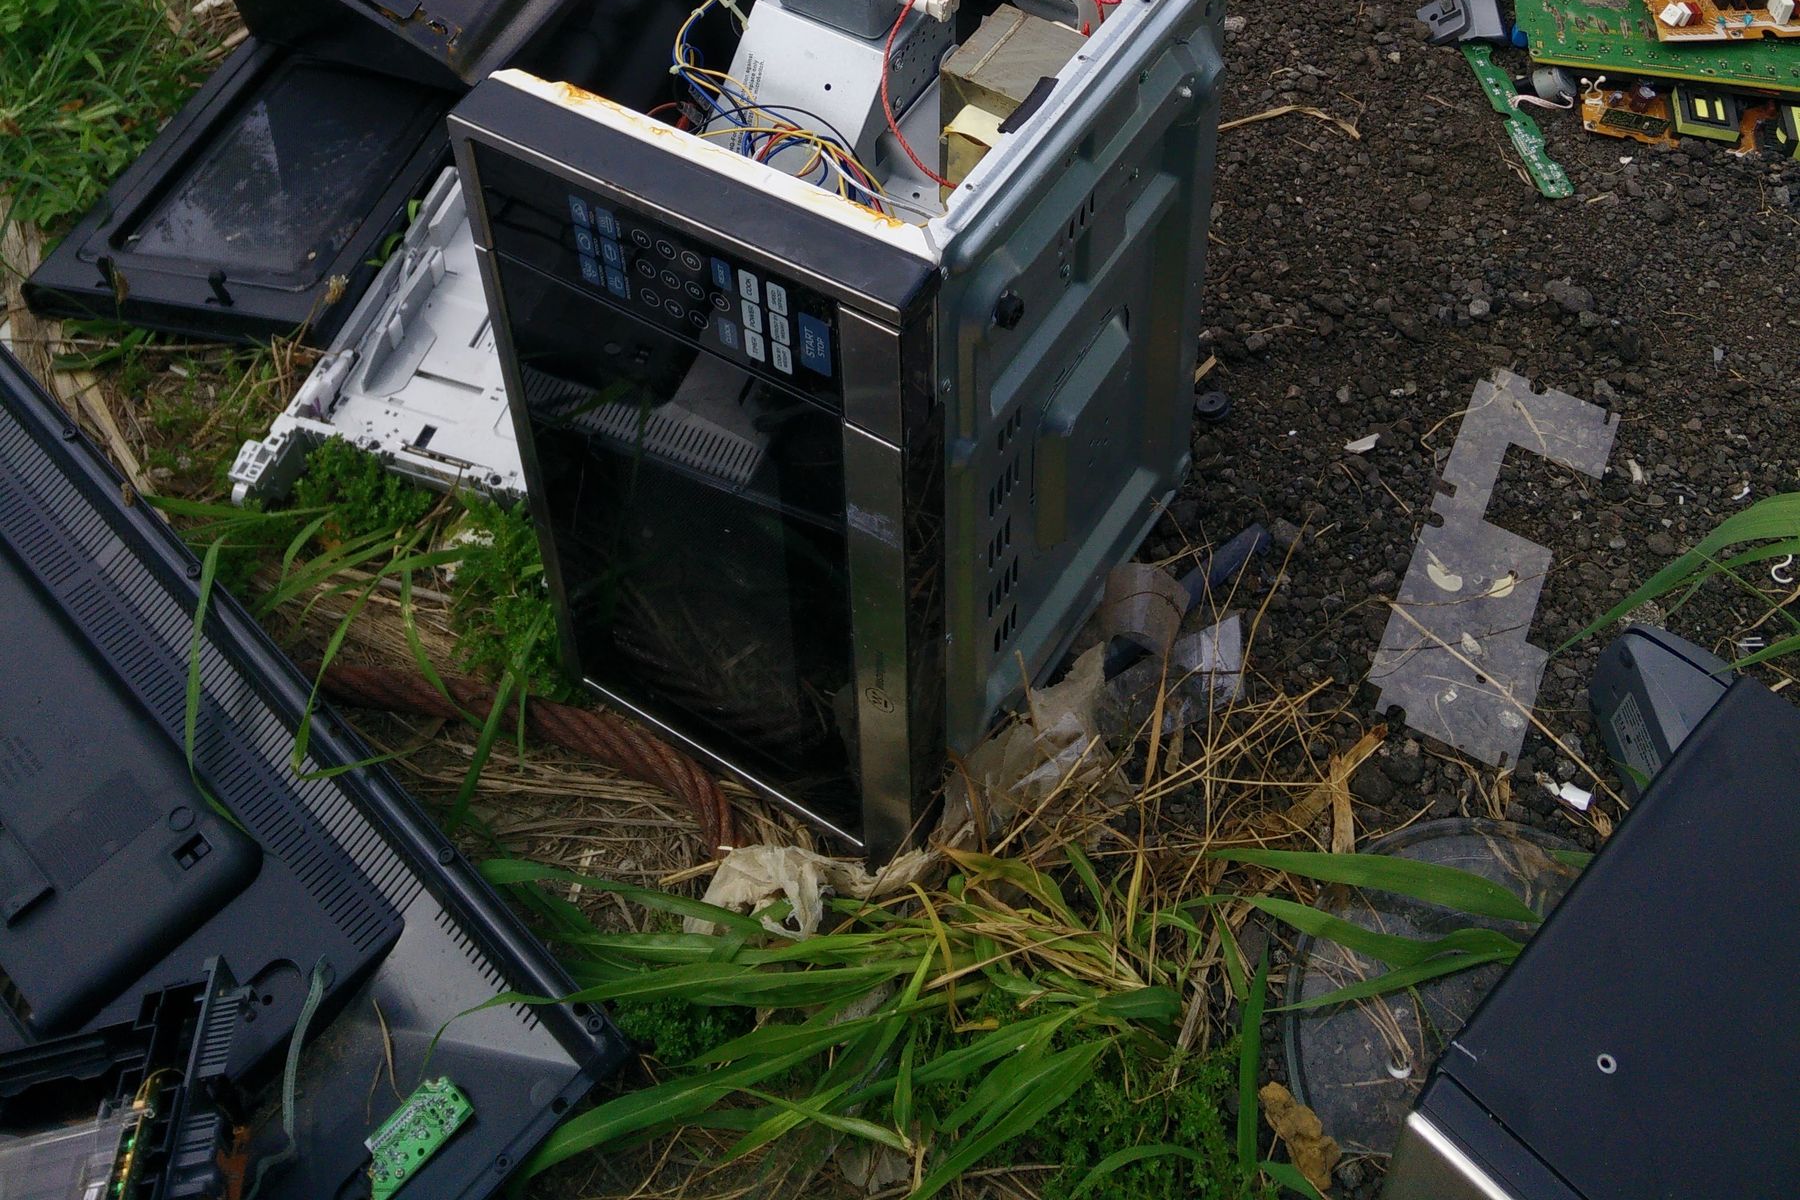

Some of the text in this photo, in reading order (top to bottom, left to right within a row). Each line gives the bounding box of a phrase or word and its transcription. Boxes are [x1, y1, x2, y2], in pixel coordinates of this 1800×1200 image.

[745, 278, 753, 296] COOK
[747, 305, 756, 328] POWER
[724, 324, 732, 344] CLOCK
[803, 324, 815, 358] START
[751, 336, 759, 354] TIMER
[816, 336, 825, 359] STOP
